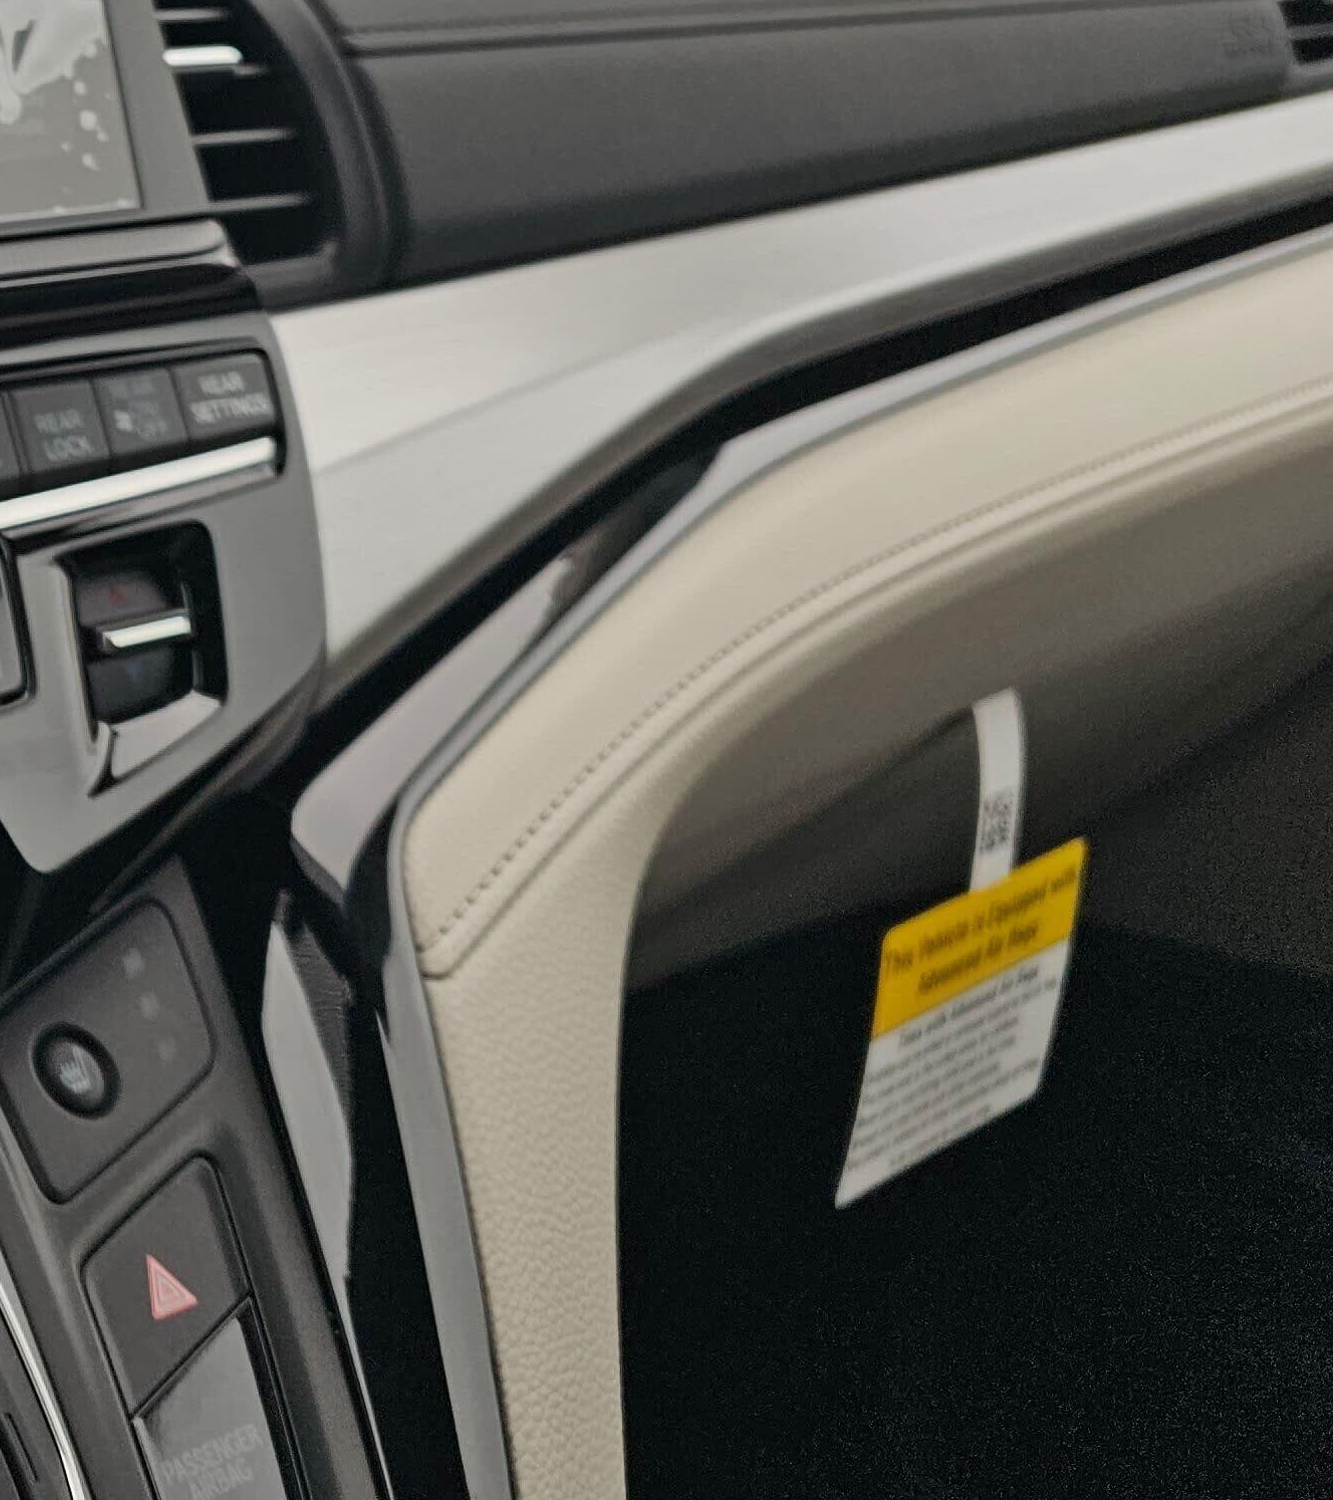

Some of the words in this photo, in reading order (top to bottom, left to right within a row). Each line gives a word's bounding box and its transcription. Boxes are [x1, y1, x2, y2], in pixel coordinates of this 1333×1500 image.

[36, 409, 81, 433] REAR
[43, 434, 92, 462] LOCK
[161, 1423, 263, 1485] PASSENGER
